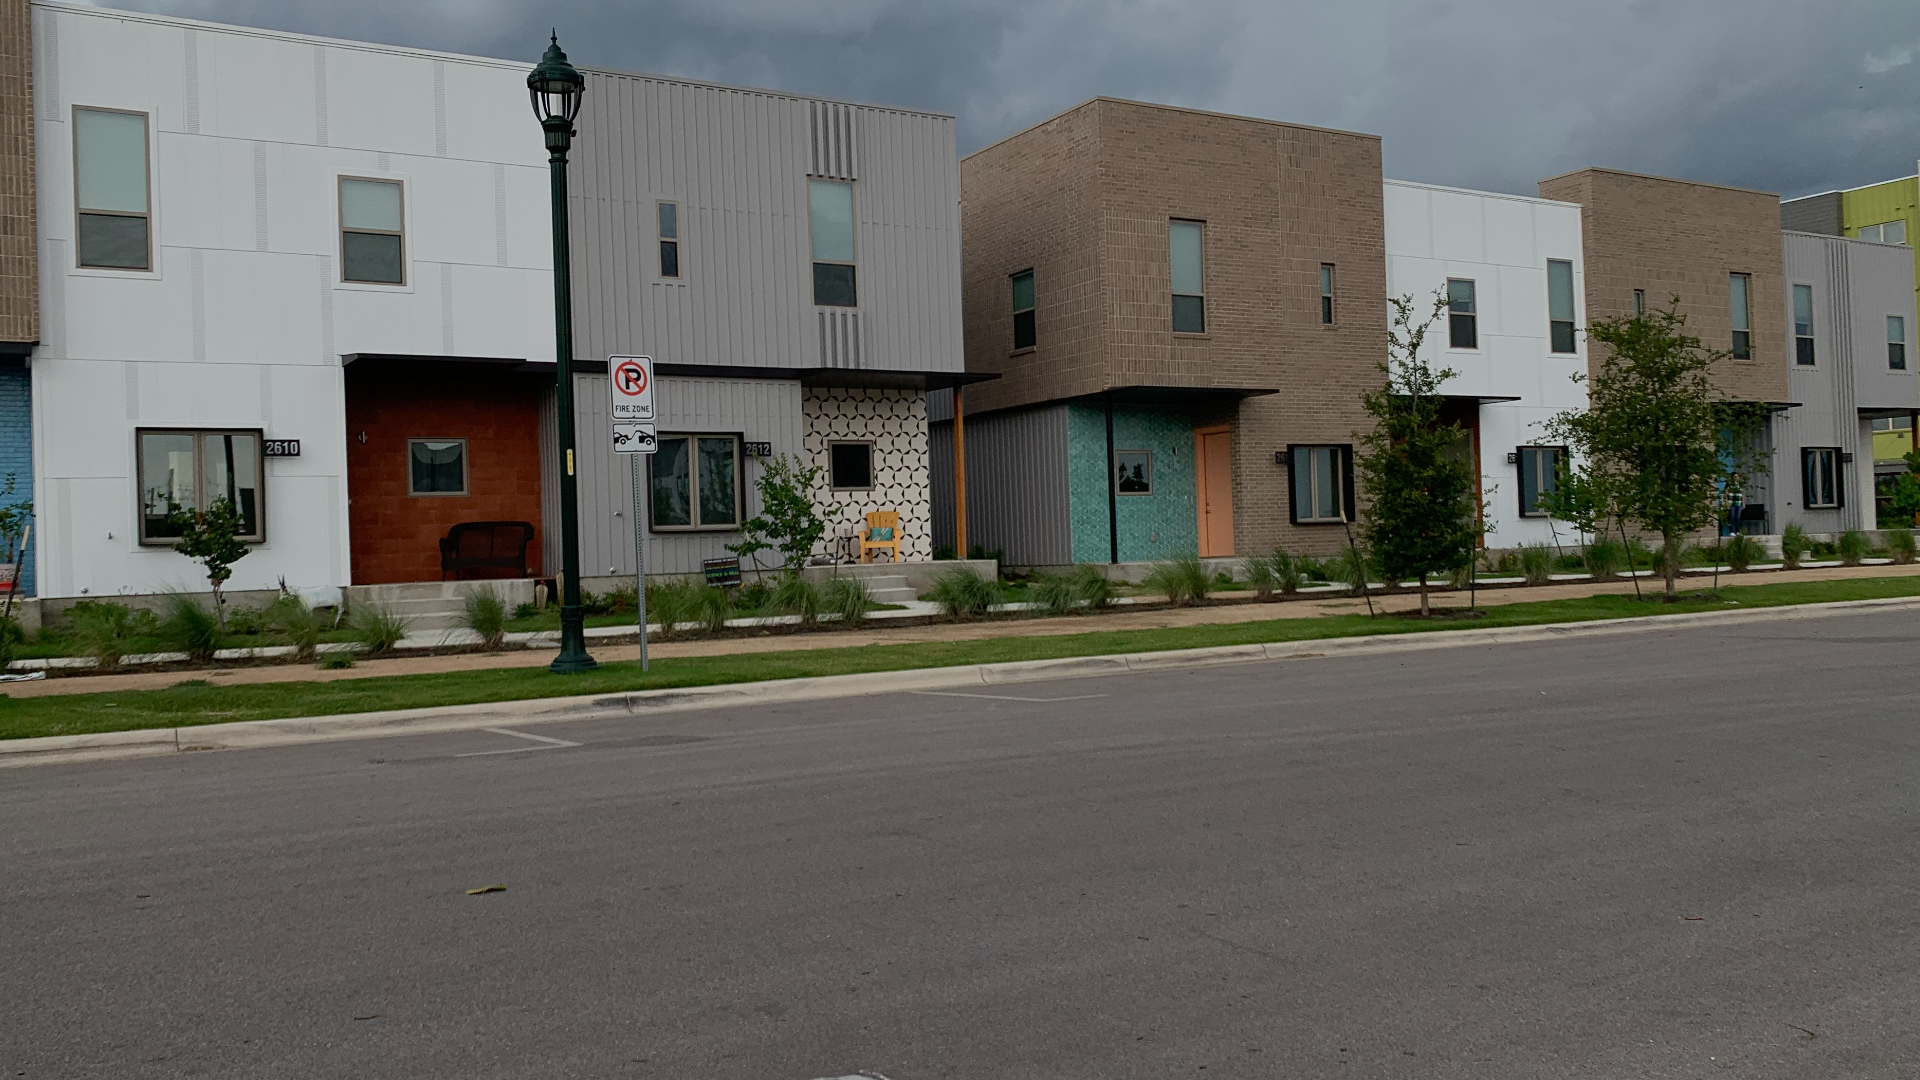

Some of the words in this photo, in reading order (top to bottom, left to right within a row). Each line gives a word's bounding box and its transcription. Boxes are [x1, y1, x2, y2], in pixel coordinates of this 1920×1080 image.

[615, 404, 630, 413] FIRE
[632, 404, 650, 413] ZONE
[266, 441, 298, 455] 2610
[745, 443, 770, 455] 2612
[1509, 454, 1517, 463] 26
